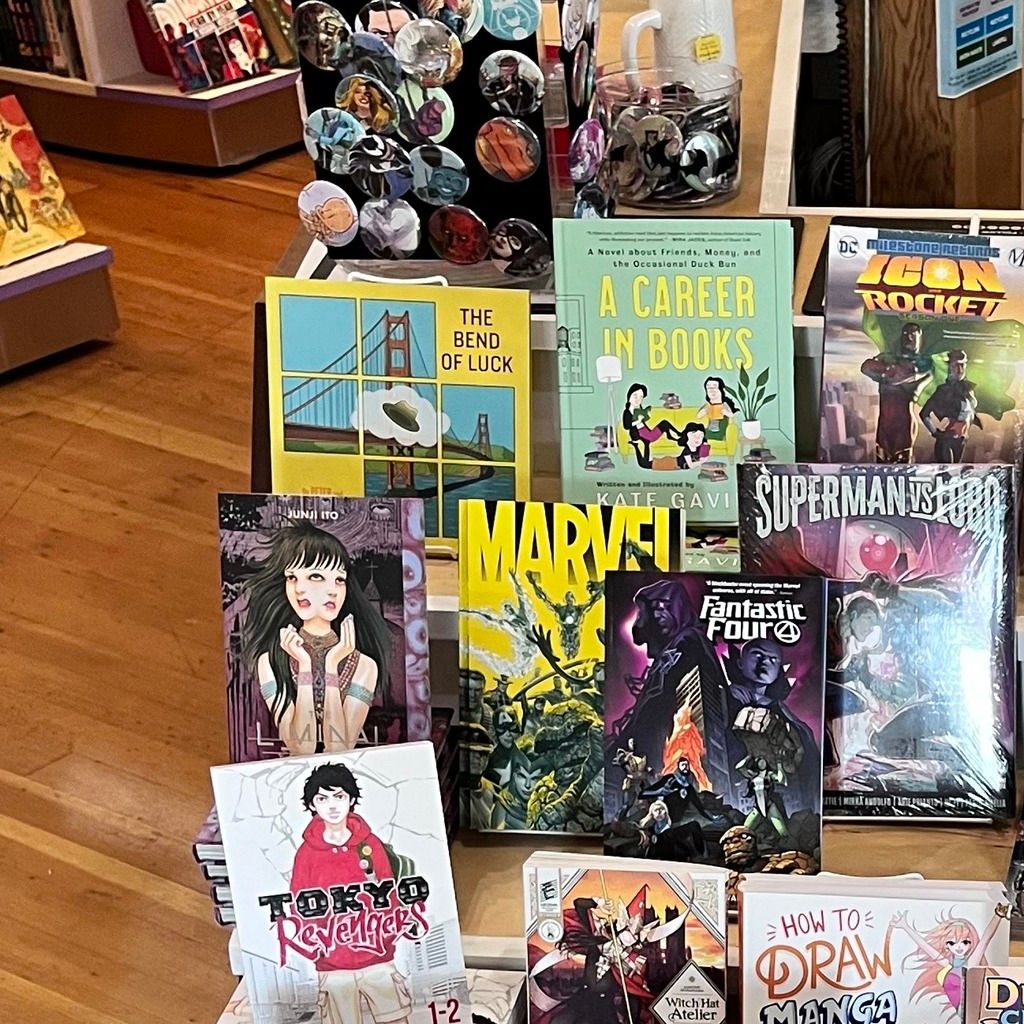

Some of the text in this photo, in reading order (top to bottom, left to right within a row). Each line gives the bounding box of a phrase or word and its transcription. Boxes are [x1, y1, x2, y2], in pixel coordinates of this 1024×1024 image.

[839, 241, 858, 255] DC
[613, 260, 714, 268] the Occasional Duck
[856, 255, 1005, 293] ICON
[600, 274, 756, 318] A CAREER
[854, 289, 1008, 317] ROCKET
[459, 308, 493, 326] THE
[453, 331, 500, 349] BEND
[602, 327, 754, 371] IN BOOKS
[441, 353, 513, 373] OF LUCK
[597, 493, 657, 508] KATE
[754, 474, 905, 540] SUPERMAN
[287, 510, 339, 520] JUNJI ITO
[700, 595, 807, 620] Fantastic
[707, 617, 773, 641] Four
[258, 876, 430, 922] TOKYO
[781, 908, 861, 939] HOW TO
[755, 922, 895, 1000] DRAW
[666, 997, 720, 1009] Witch Hat
[667, 1008, 718, 1022] Atelier
